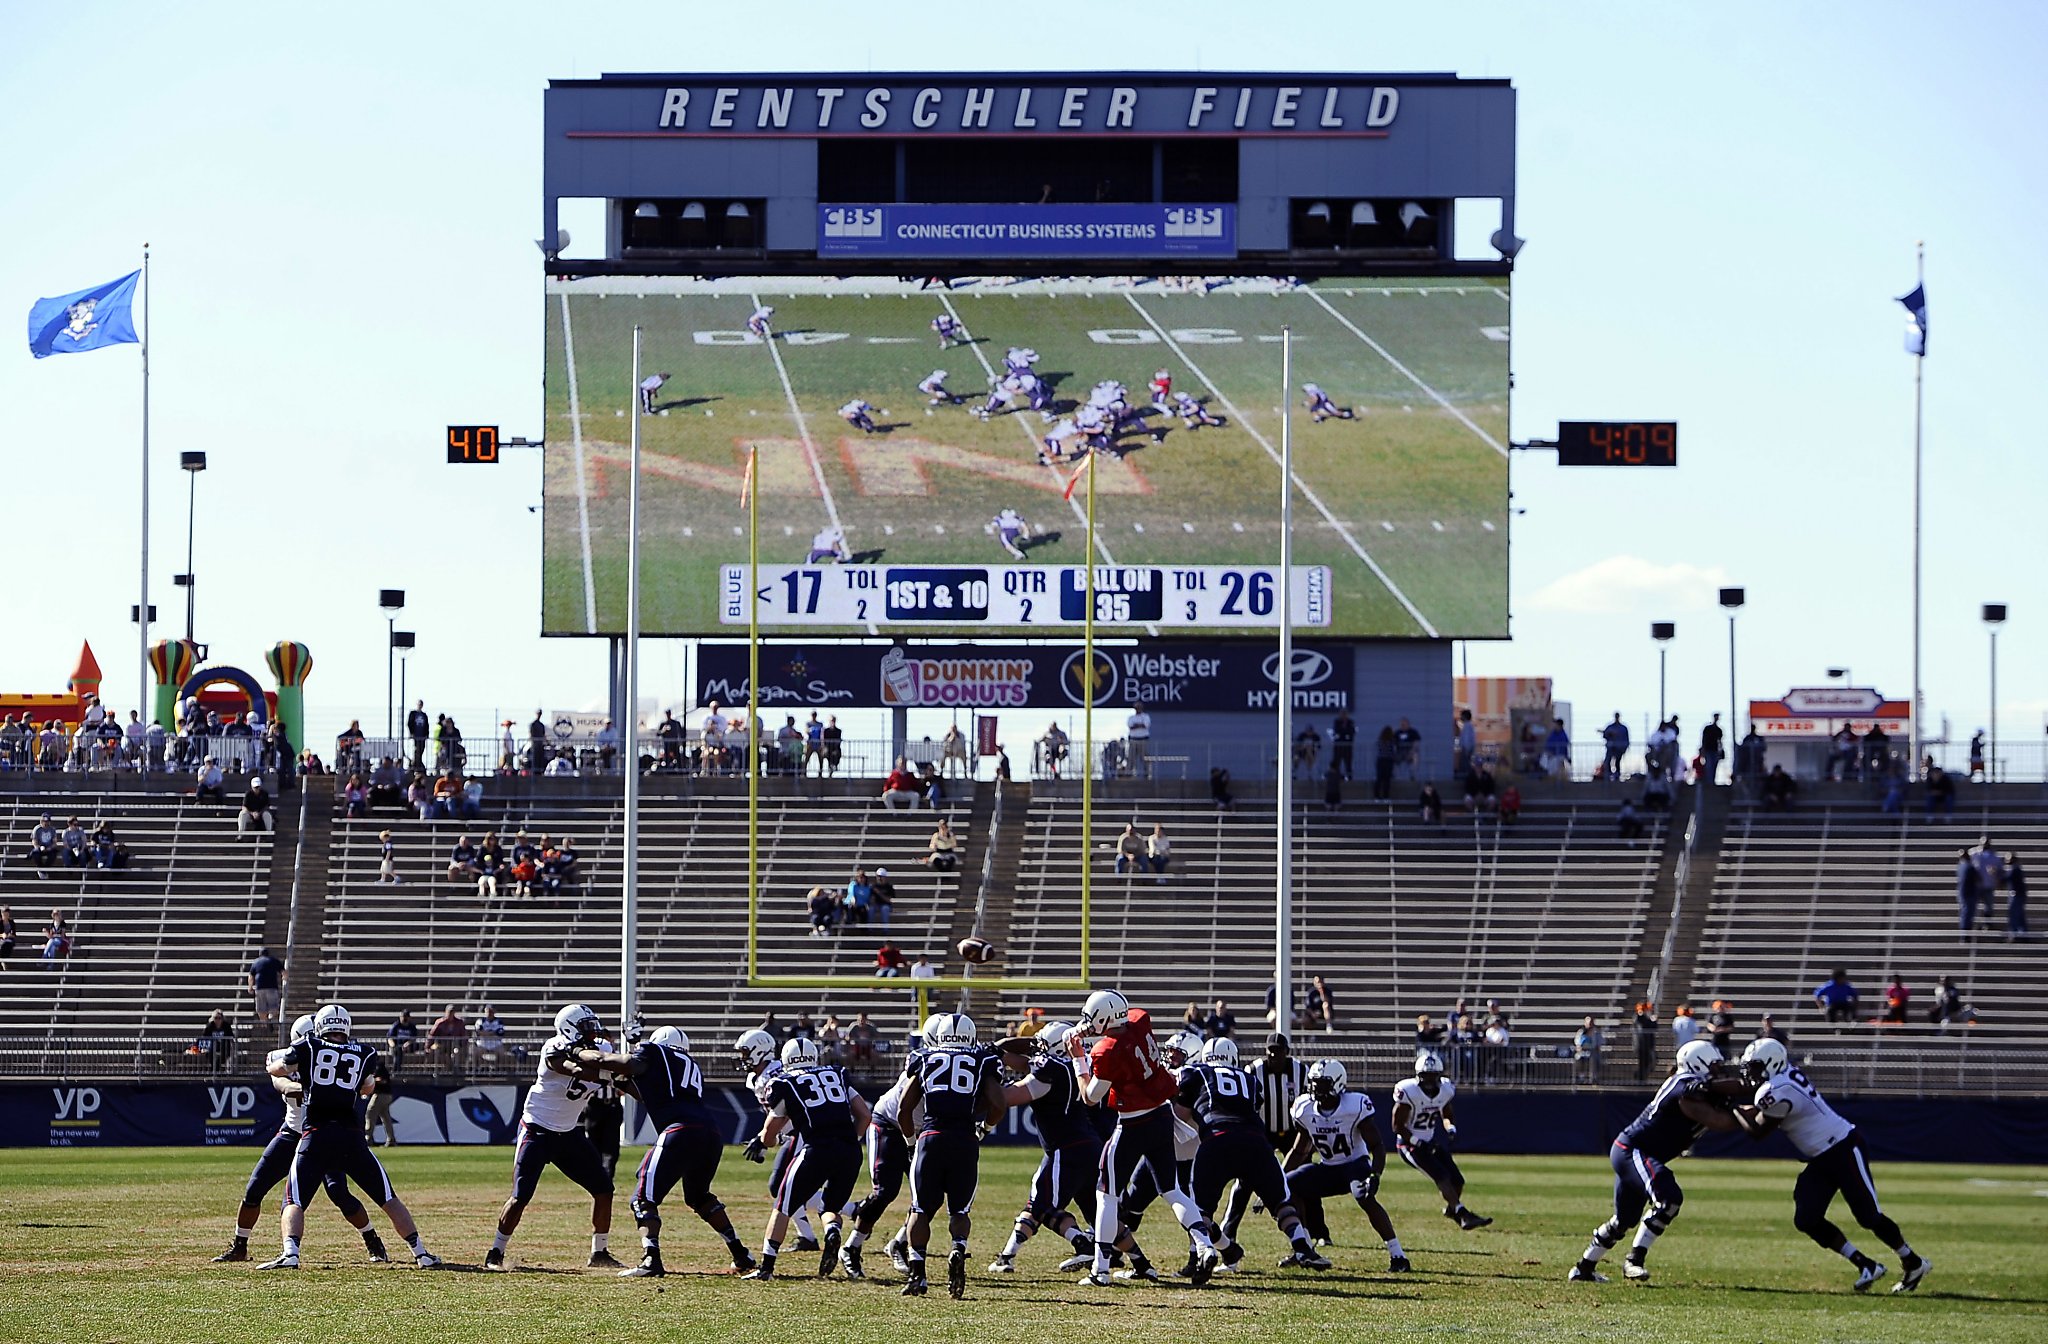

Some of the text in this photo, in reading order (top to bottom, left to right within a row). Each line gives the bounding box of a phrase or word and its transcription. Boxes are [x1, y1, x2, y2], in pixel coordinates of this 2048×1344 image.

[659, 86, 1400, 129] RENTSCHLER FIELD
[897, 224, 1156, 240] CONNECTICUT BUSINESS SYSTEMS
[449, 427, 496, 461] 40
[1589, 424, 1675, 463] 4:09
[781, 570, 823, 614] 17
[844, 570, 878, 589] TOL
[1003, 570, 1047, 595] QTR
[1122, 567, 1153, 592] ON
[1173, 570, 1206, 590] TOL
[727, 568, 742, 617] BLUE
[886, 580, 989, 610] 1ST & 10
[1219, 571, 1275, 616] 26
[1307, 566, 1325, 624] WHITE
[856, 600, 867, 620] 2
[1020, 598, 1033, 622] 2
[1096, 593, 1131, 622] 35
[1185, 600, 1197, 621] 3
[921, 661, 1032, 682] DUNKIN'
[1122, 653, 1221, 678] Webster
[805, 680, 854, 704] Sun
[921, 683, 1027, 704] DONUTS
[1123, 678, 1183, 702] Bank
[1247, 690, 1347, 708] HYNDAI
[322, 1017, 350, 1026] UCONN
[940, 1034, 971, 1043] UCONN
[313, 1048, 362, 1090] 83
[787, 1054, 816, 1065] UCONN
[1134, 1032, 1161, 1081] 14
[673, 1051, 703, 1098] 74
[925, 1052, 976, 1094] 26
[1214, 1067, 1250, 1100] 61
[796, 1070, 846, 1108] 38
[53, 1087, 101, 1119] yp
[207, 1086, 255, 1118] yp
[50, 1129, 64, 1137] the
[83, 1130, 100, 1138] way
[205, 1128, 255, 1137] the new way
[1315, 1126, 1340, 1134] UCONN
[1312, 1133, 1352, 1160] 54
